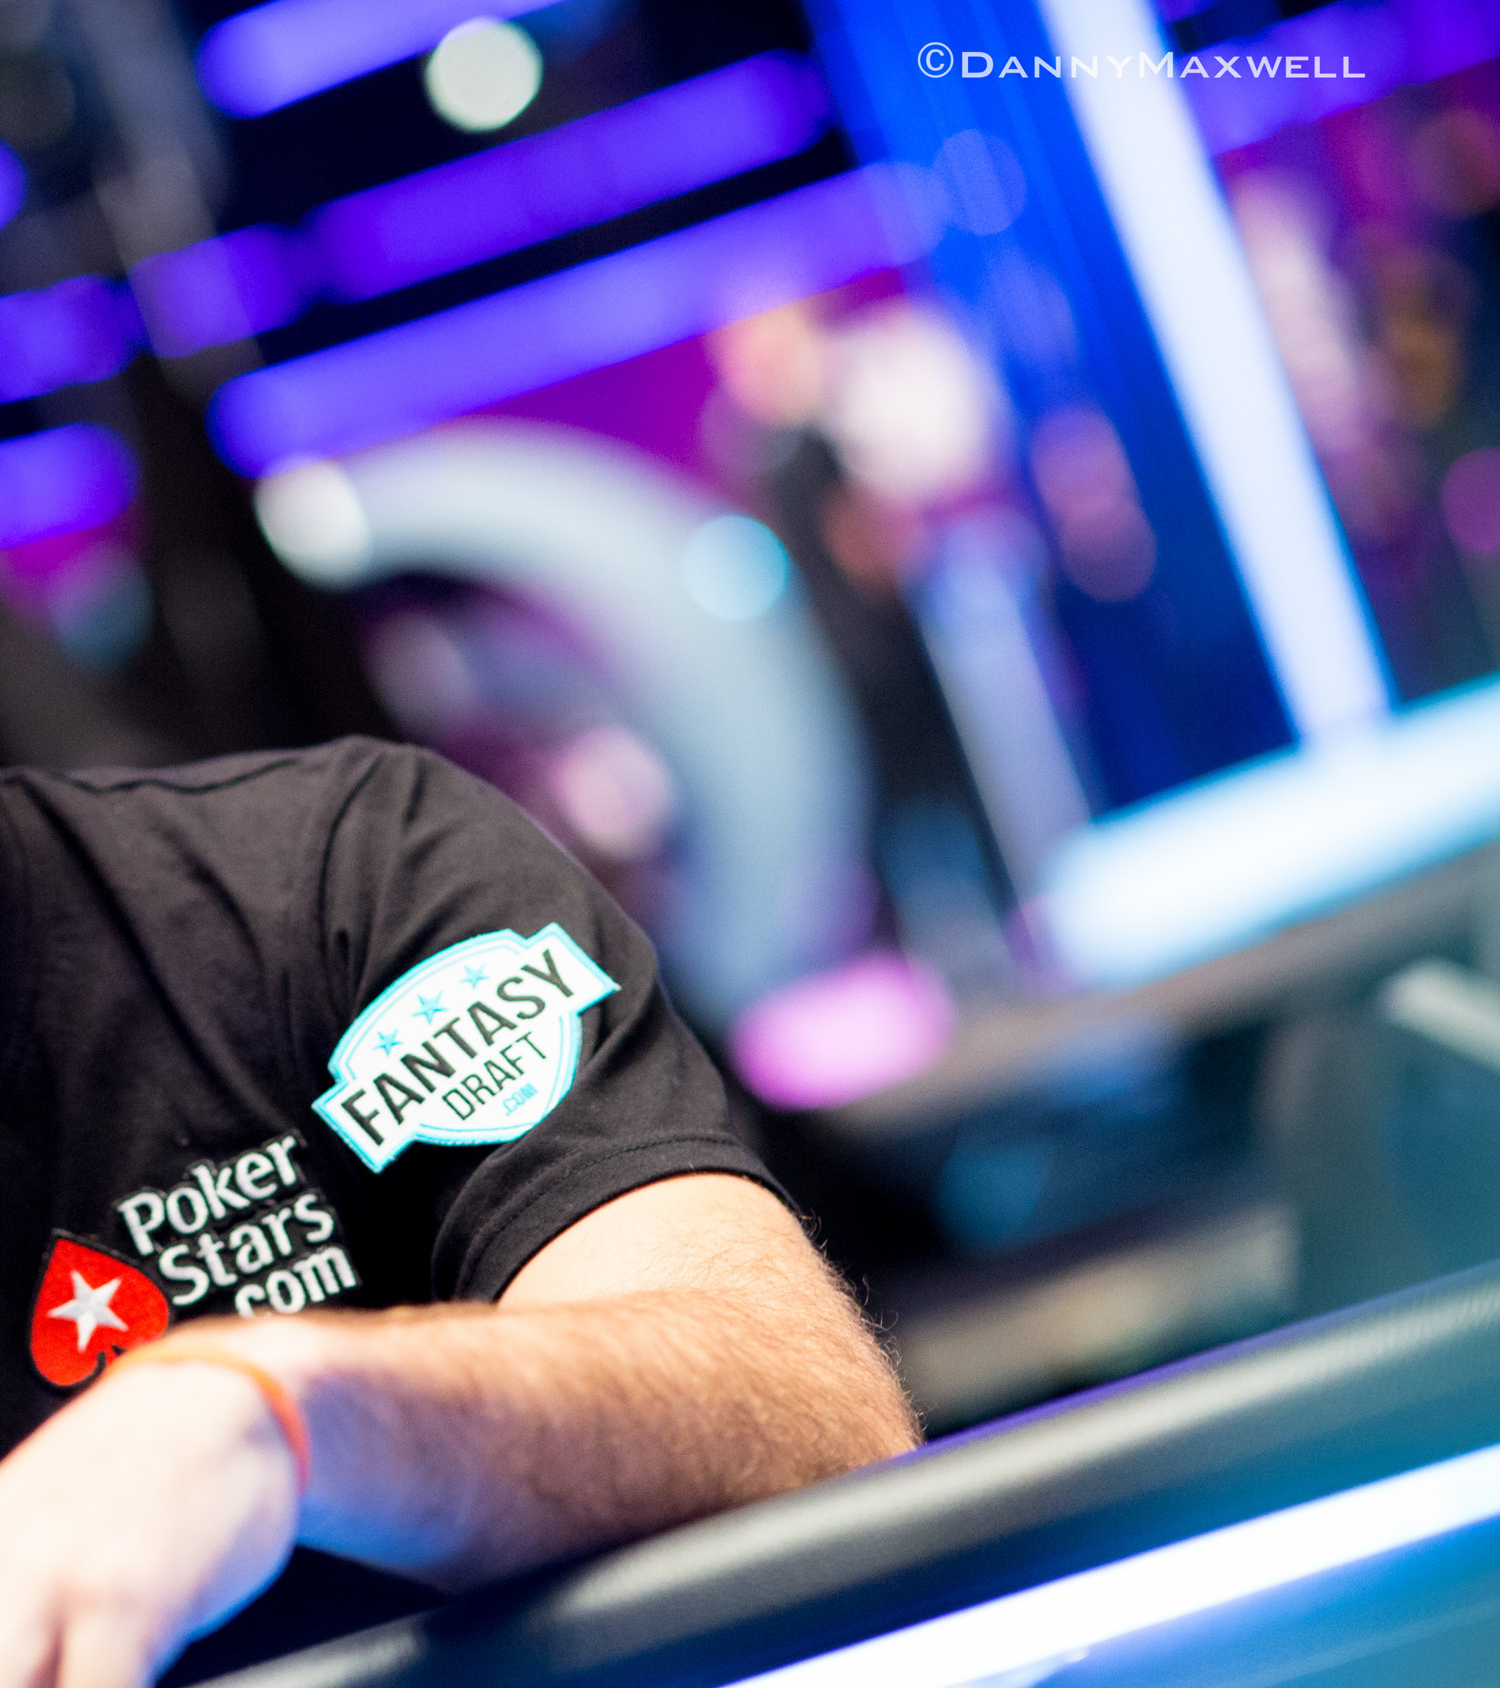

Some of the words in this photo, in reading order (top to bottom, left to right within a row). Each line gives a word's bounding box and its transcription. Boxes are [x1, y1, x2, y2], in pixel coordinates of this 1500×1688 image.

[340, 948, 575, 1147] FANTASY
[441, 1031, 548, 1122] DRAFT
[116, 1134, 297, 1256] Poker
[158, 1193, 335, 1307] Stars
